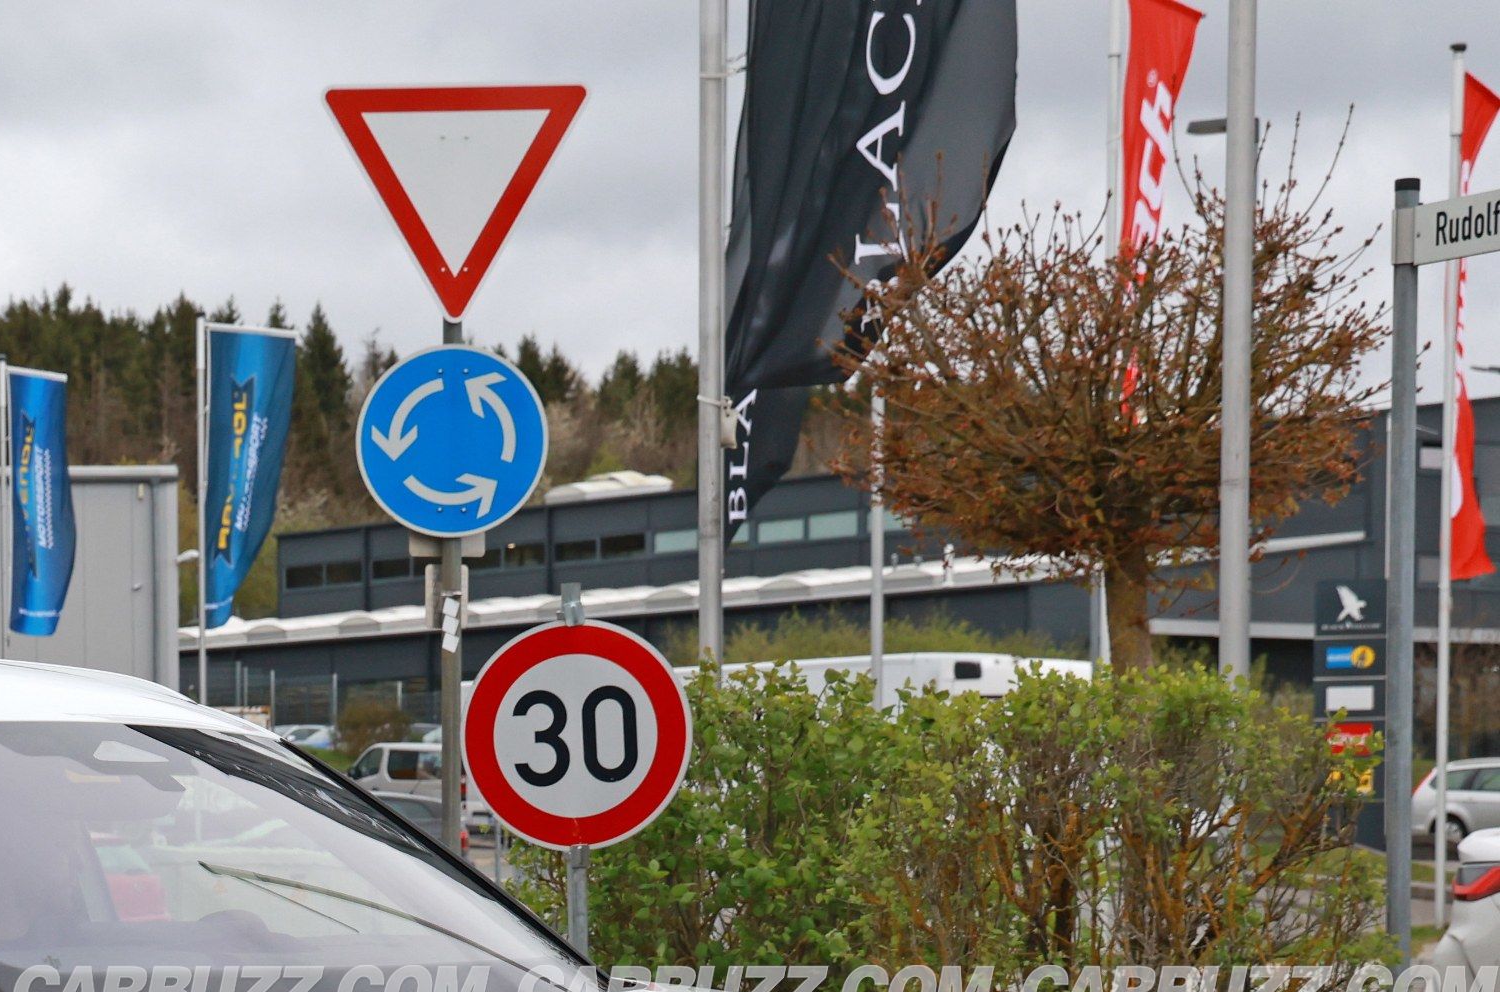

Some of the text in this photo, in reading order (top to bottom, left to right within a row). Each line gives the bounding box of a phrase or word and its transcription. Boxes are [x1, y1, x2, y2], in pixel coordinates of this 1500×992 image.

[856, 0, 922, 336] LAC
[1435, 199, 1500, 247] Rudolf
[728, 388, 758, 525] BLA
[512, 685, 639, 787] 30
